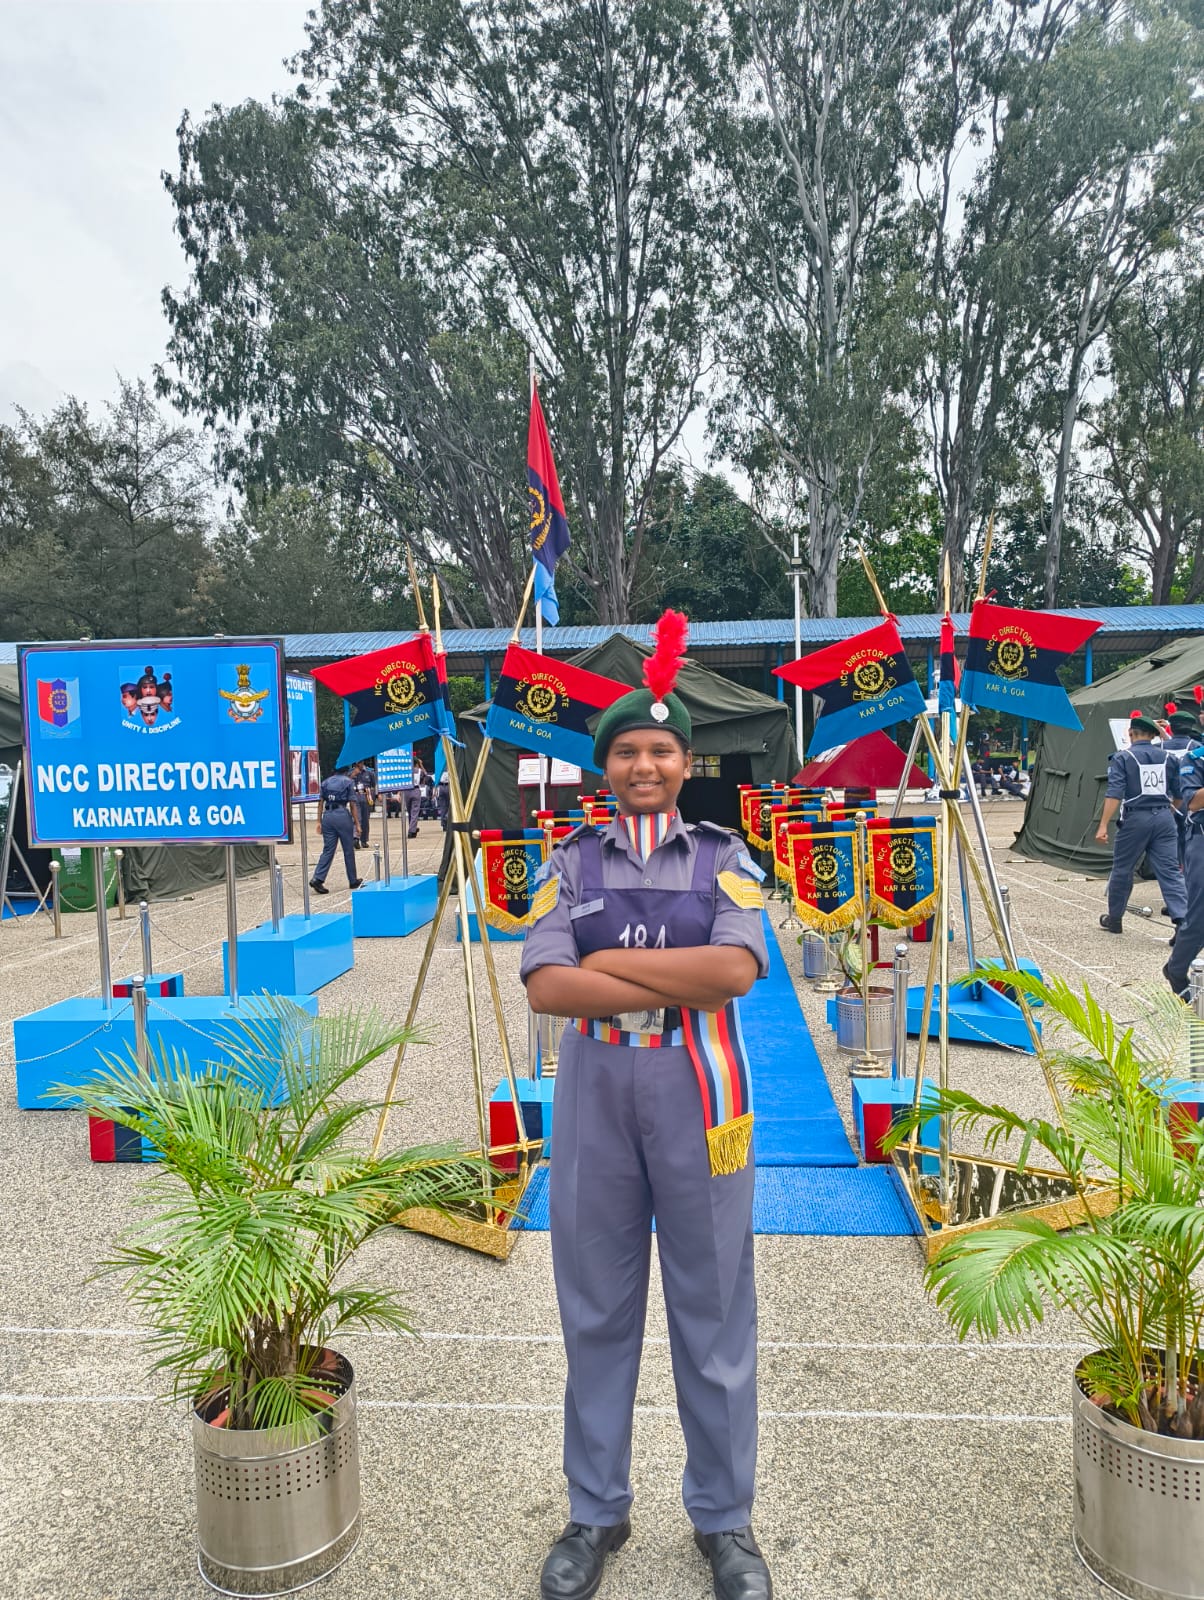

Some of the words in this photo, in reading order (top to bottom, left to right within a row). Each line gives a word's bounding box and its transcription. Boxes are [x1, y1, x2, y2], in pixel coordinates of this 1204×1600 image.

[985, 634, 998, 652] NCC
[998, 625, 1037, 660] DIRECTORATE
[374, 678, 384, 696] NCC
[380, 660, 427, 684] DIRECTORATE
[840, 669, 849, 687] NCC
[845, 649, 897, 669] DIRECTORATE
[514, 676, 530, 693] NCC
[531, 672, 570, 709] DIRECTORATE
[985, 682, 1000, 693] KAR
[1002, 685, 1007, 694] &
[1010, 687, 1025, 697] GOA
[859, 706, 877, 719] KAR
[878, 703, 885, 711] &
[886, 695, 905, 707] GOA
[388, 720, 404, 732] KAR
[406, 717, 412, 725] &
[413, 712, 430, 723] GOA
[509, 718, 526, 731] KAR
[527, 725, 533, 733] &
[536, 728, 552, 740] GOA
[37, 764, 90, 793] NCC
[97, 760, 277, 792] DIRECTORATE
[1142, 770, 1165, 788] 204
[72, 806, 183, 828] KARNATAKA
[188, 807, 202, 826] &
[206, 805, 246, 826] GOA
[799, 855, 810, 870] NCC
[809, 844, 851, 868] DIRECTORATE
[876, 847, 888, 862] NCC
[887, 837, 930, 861] DIRECTORATE
[498, 893, 511, 901] KAR
[807, 891, 822, 900] KAR
[832, 890, 847, 898] GOA
[883, 884, 898, 892] KAR
